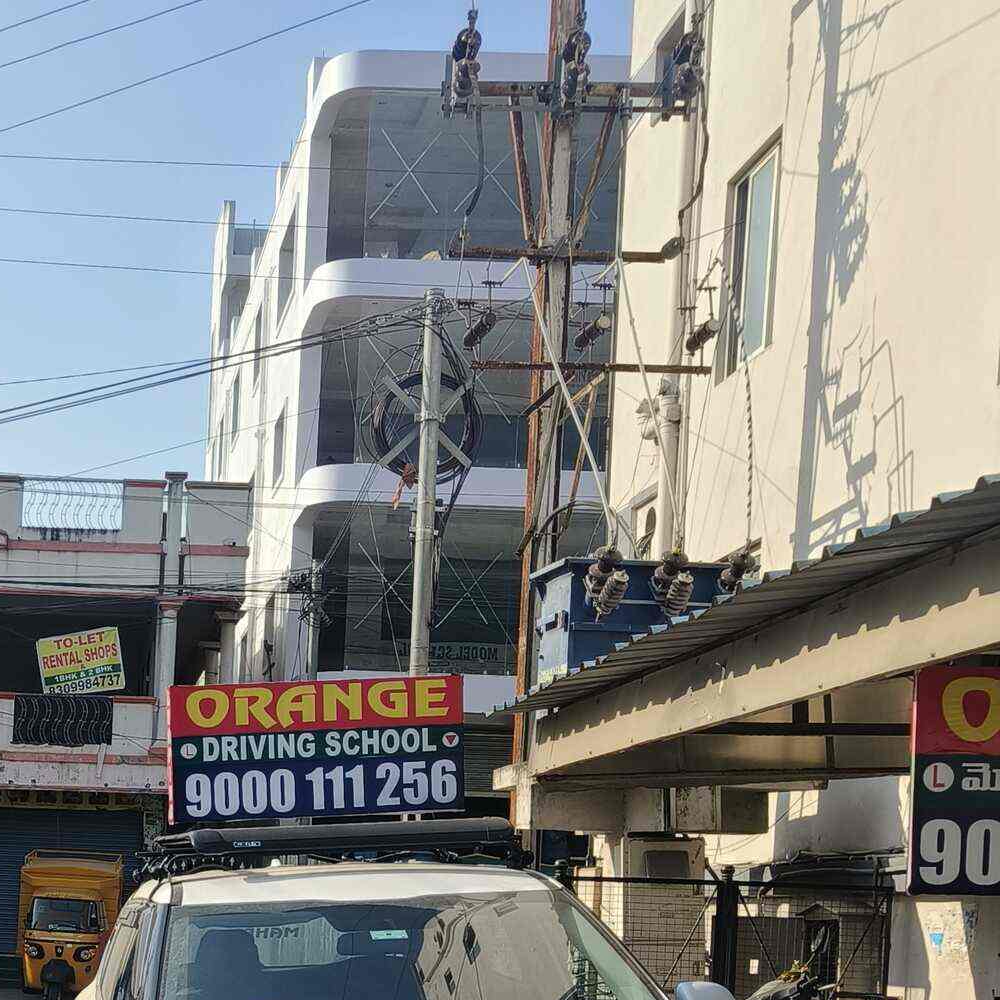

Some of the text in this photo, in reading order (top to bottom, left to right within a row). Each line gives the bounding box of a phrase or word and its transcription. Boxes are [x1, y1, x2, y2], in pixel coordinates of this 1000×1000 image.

[54, 631, 105, 649] TO-LET
[42, 643, 118, 669] RENTAL SHOPS
[48, 674, 121, 694] 8309984737
[54, 673, 78, 682] 1BHK
[185, 679, 451, 730] ORANGE
[203, 732, 316, 763] DRIVING
[325, 727, 437, 757] SCHOOL
[185, 758, 458, 818] 9000 111 256
